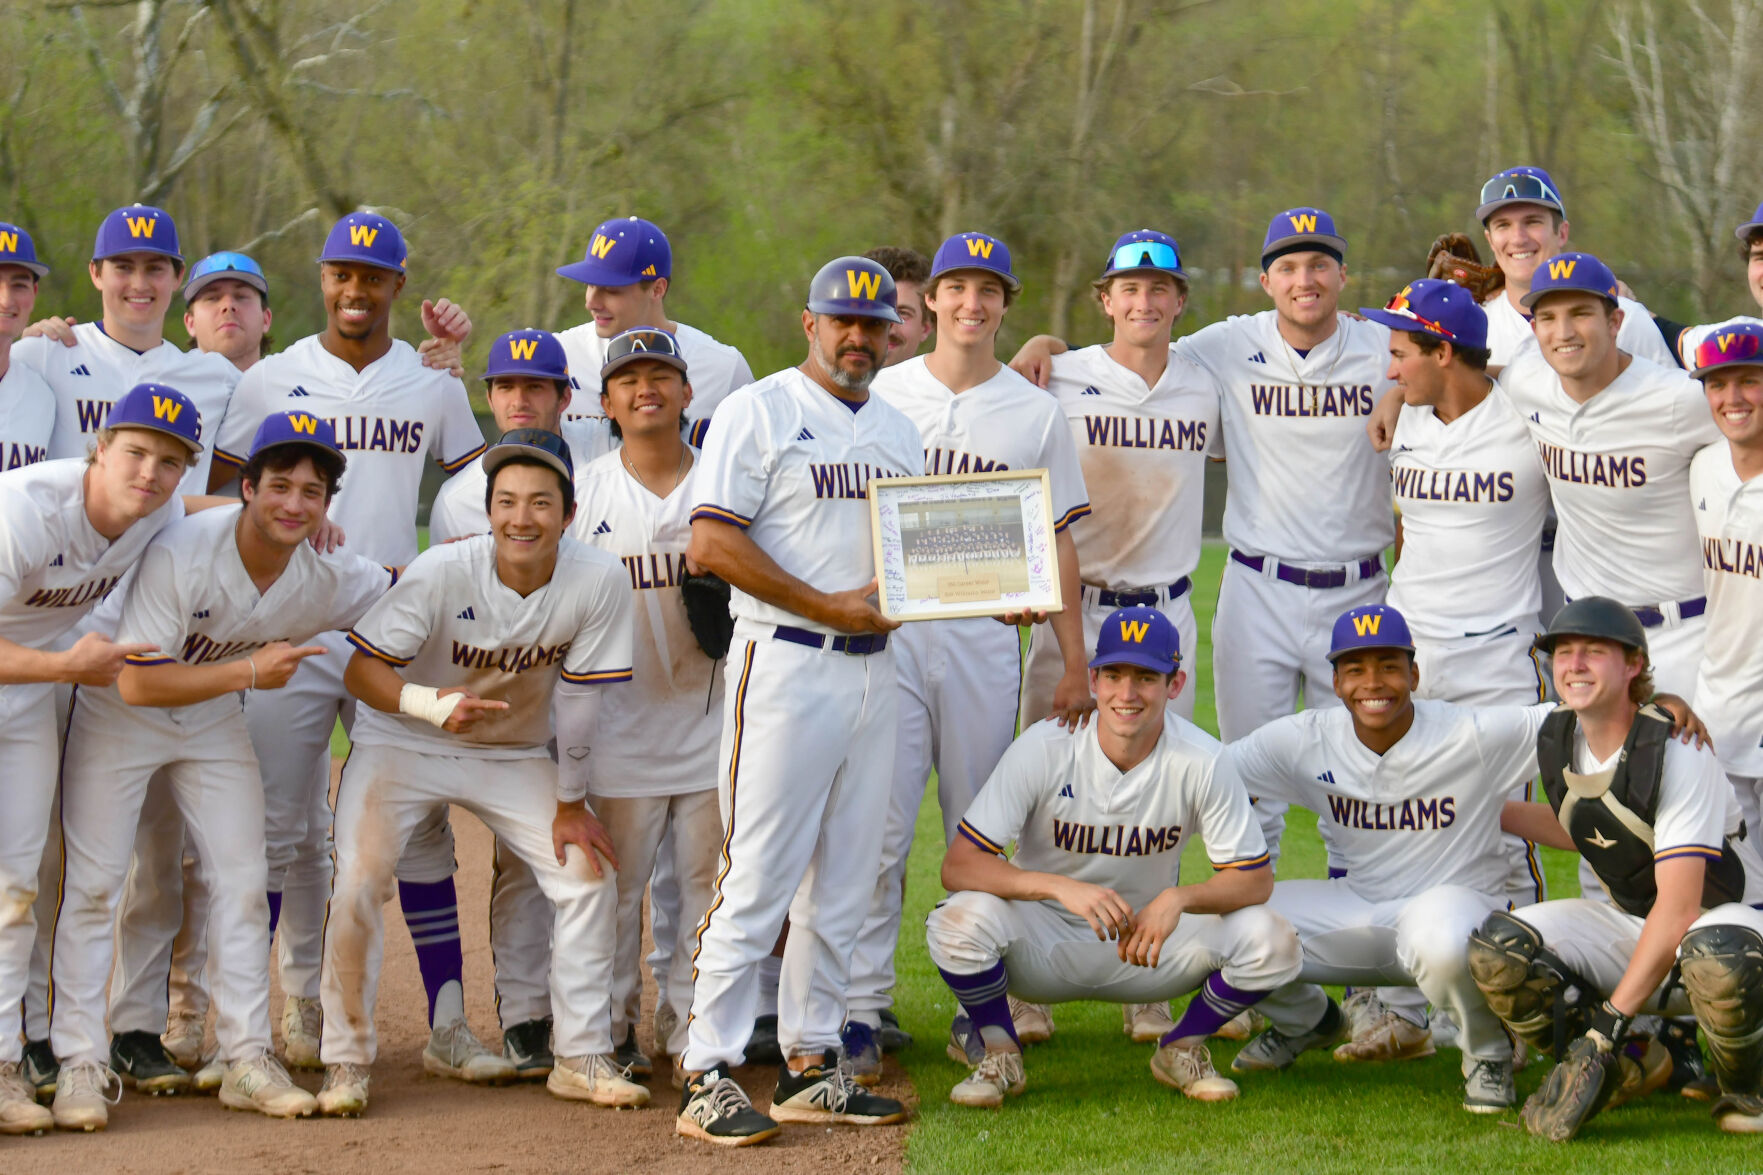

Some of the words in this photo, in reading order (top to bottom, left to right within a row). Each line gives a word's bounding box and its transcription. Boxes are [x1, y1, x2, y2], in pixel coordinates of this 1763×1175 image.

[126, 216, 156, 239] W
[350, 225, 379, 248] W
[1290, 214, 1317, 233] W
[591, 234, 616, 259] W
[966, 238, 994, 260] W
[1549, 259, 1577, 281] W
[847, 269, 882, 301] W
[510, 339, 538, 361] W
[152, 395, 183, 424] W
[1250, 384, 1374, 418] WILLIAMS
[287, 413, 318, 435] W
[321, 415, 425, 454] LLIAMS
[1084, 415, 1207, 452] WILLIAMS
[1538, 440, 1647, 488] WILLIAMS
[1393, 468, 1515, 503] WILLIAMS
[1119, 619, 1151, 643] W
[1351, 614, 1382, 637] W
[451, 639, 572, 674] WILLIAMS
[1326, 793, 1457, 831] WILLIAMS
[1052, 818, 1182, 857] WILLIAMS
